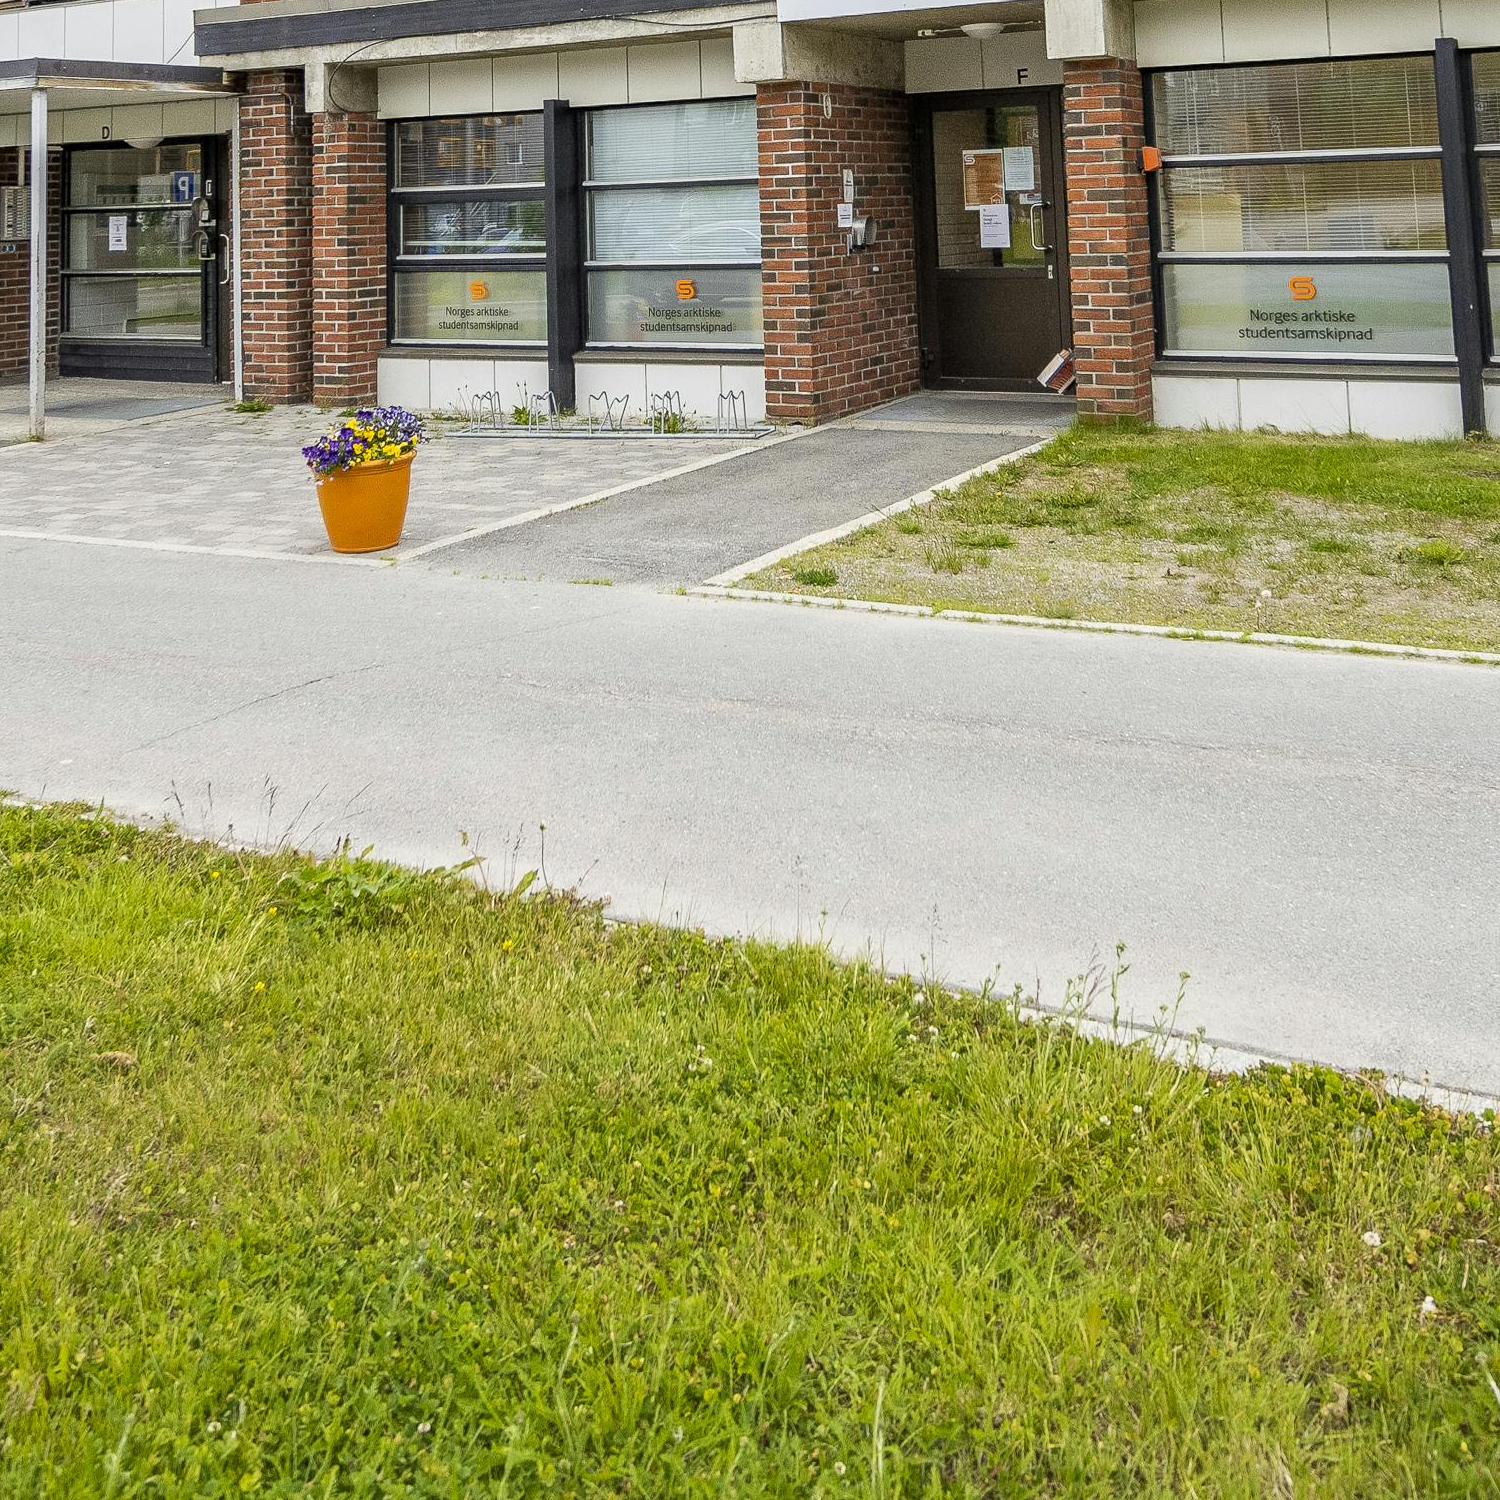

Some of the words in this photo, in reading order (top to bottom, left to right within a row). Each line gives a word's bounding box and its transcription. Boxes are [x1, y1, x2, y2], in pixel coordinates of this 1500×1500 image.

[1017, 67, 1029, 85] F
[101, 126, 110, 140] D
[445, 306, 475, 319] Norges
[476, 306, 509, 318] arktiske
[648, 306, 682, 319] Norges
[683, 307, 722, 318] arktiske
[1250, 309, 1298, 325] Norges
[1301, 309, 1356, 323] arktiske
[438, 320, 519, 332] studentsamskipnad
[640, 321, 733, 334] studentsamskipnad
[1238, 327, 1373, 343] studentsamskipnad
